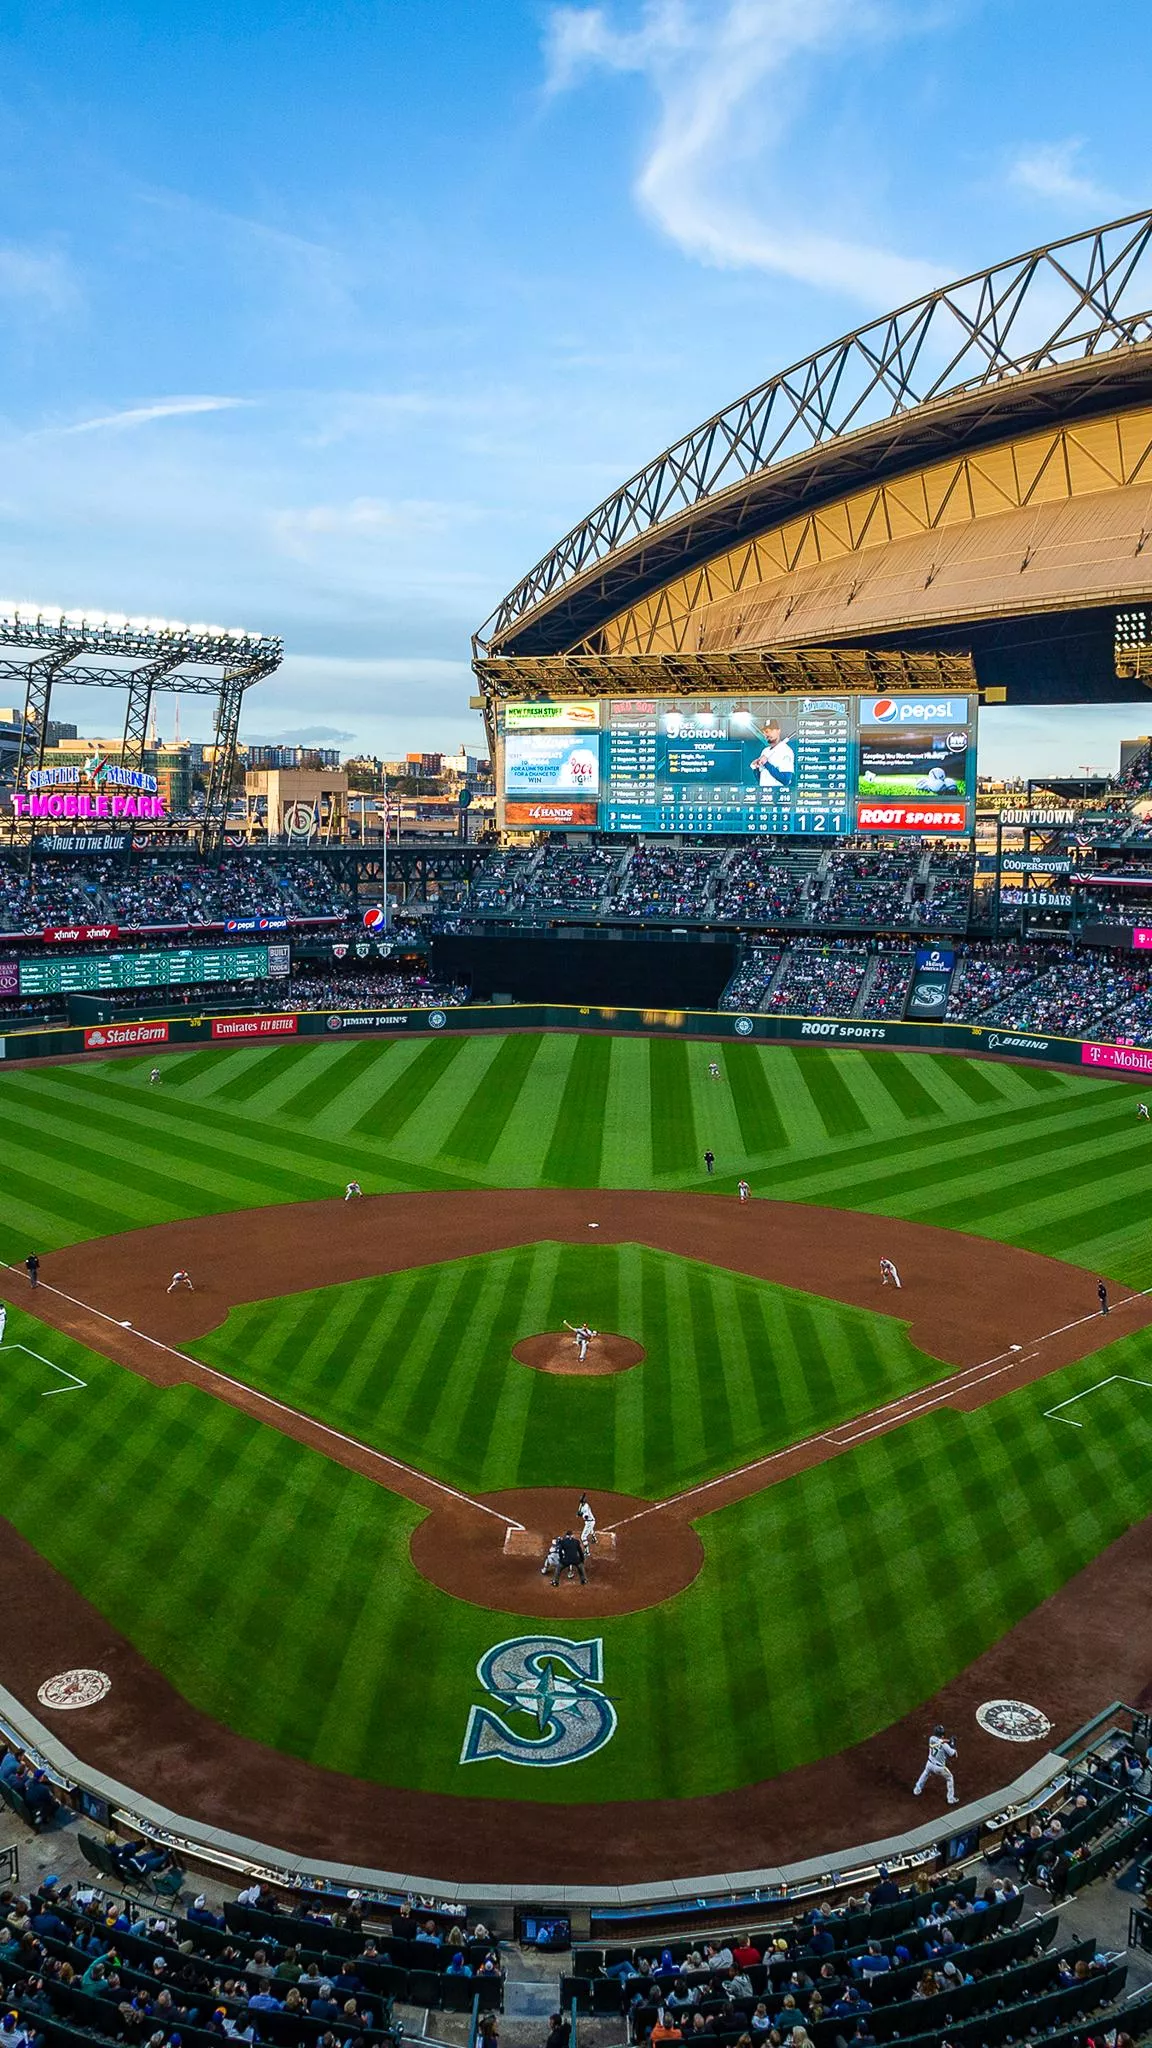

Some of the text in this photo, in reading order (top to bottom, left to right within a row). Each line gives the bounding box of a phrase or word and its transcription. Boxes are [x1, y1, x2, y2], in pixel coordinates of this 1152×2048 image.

[900, 702, 953, 720] pepsi
[667, 723, 679, 738] 9
[680, 730, 726, 738] GORDON
[10, 793, 166, 817] T-MOBILE PARK
[529, 806, 541, 818] 14
[799, 815, 840, 831] 1 2 1
[860, 810, 905, 824] ROOT
[1000, 809, 1075, 824] COUNTDOWN
[52, 835, 125, 850] TRUE TO THE BLUE
[1003, 859, 1071, 872] COOPERSTOWN
[1022, 893, 1072, 906] 115 DAYS
[237, 919, 286, 930] pepsi pepsi
[54, 929, 111, 940] xfinity xfinity
[216, 1019, 293, 1034] Emirates FLY BETTER
[343, 1016, 408, 1027] JIMMY JOHN'S
[801, 1023, 885, 1038] ROOT SPORTS
[1002, 1038, 1048, 1050] BOEING
